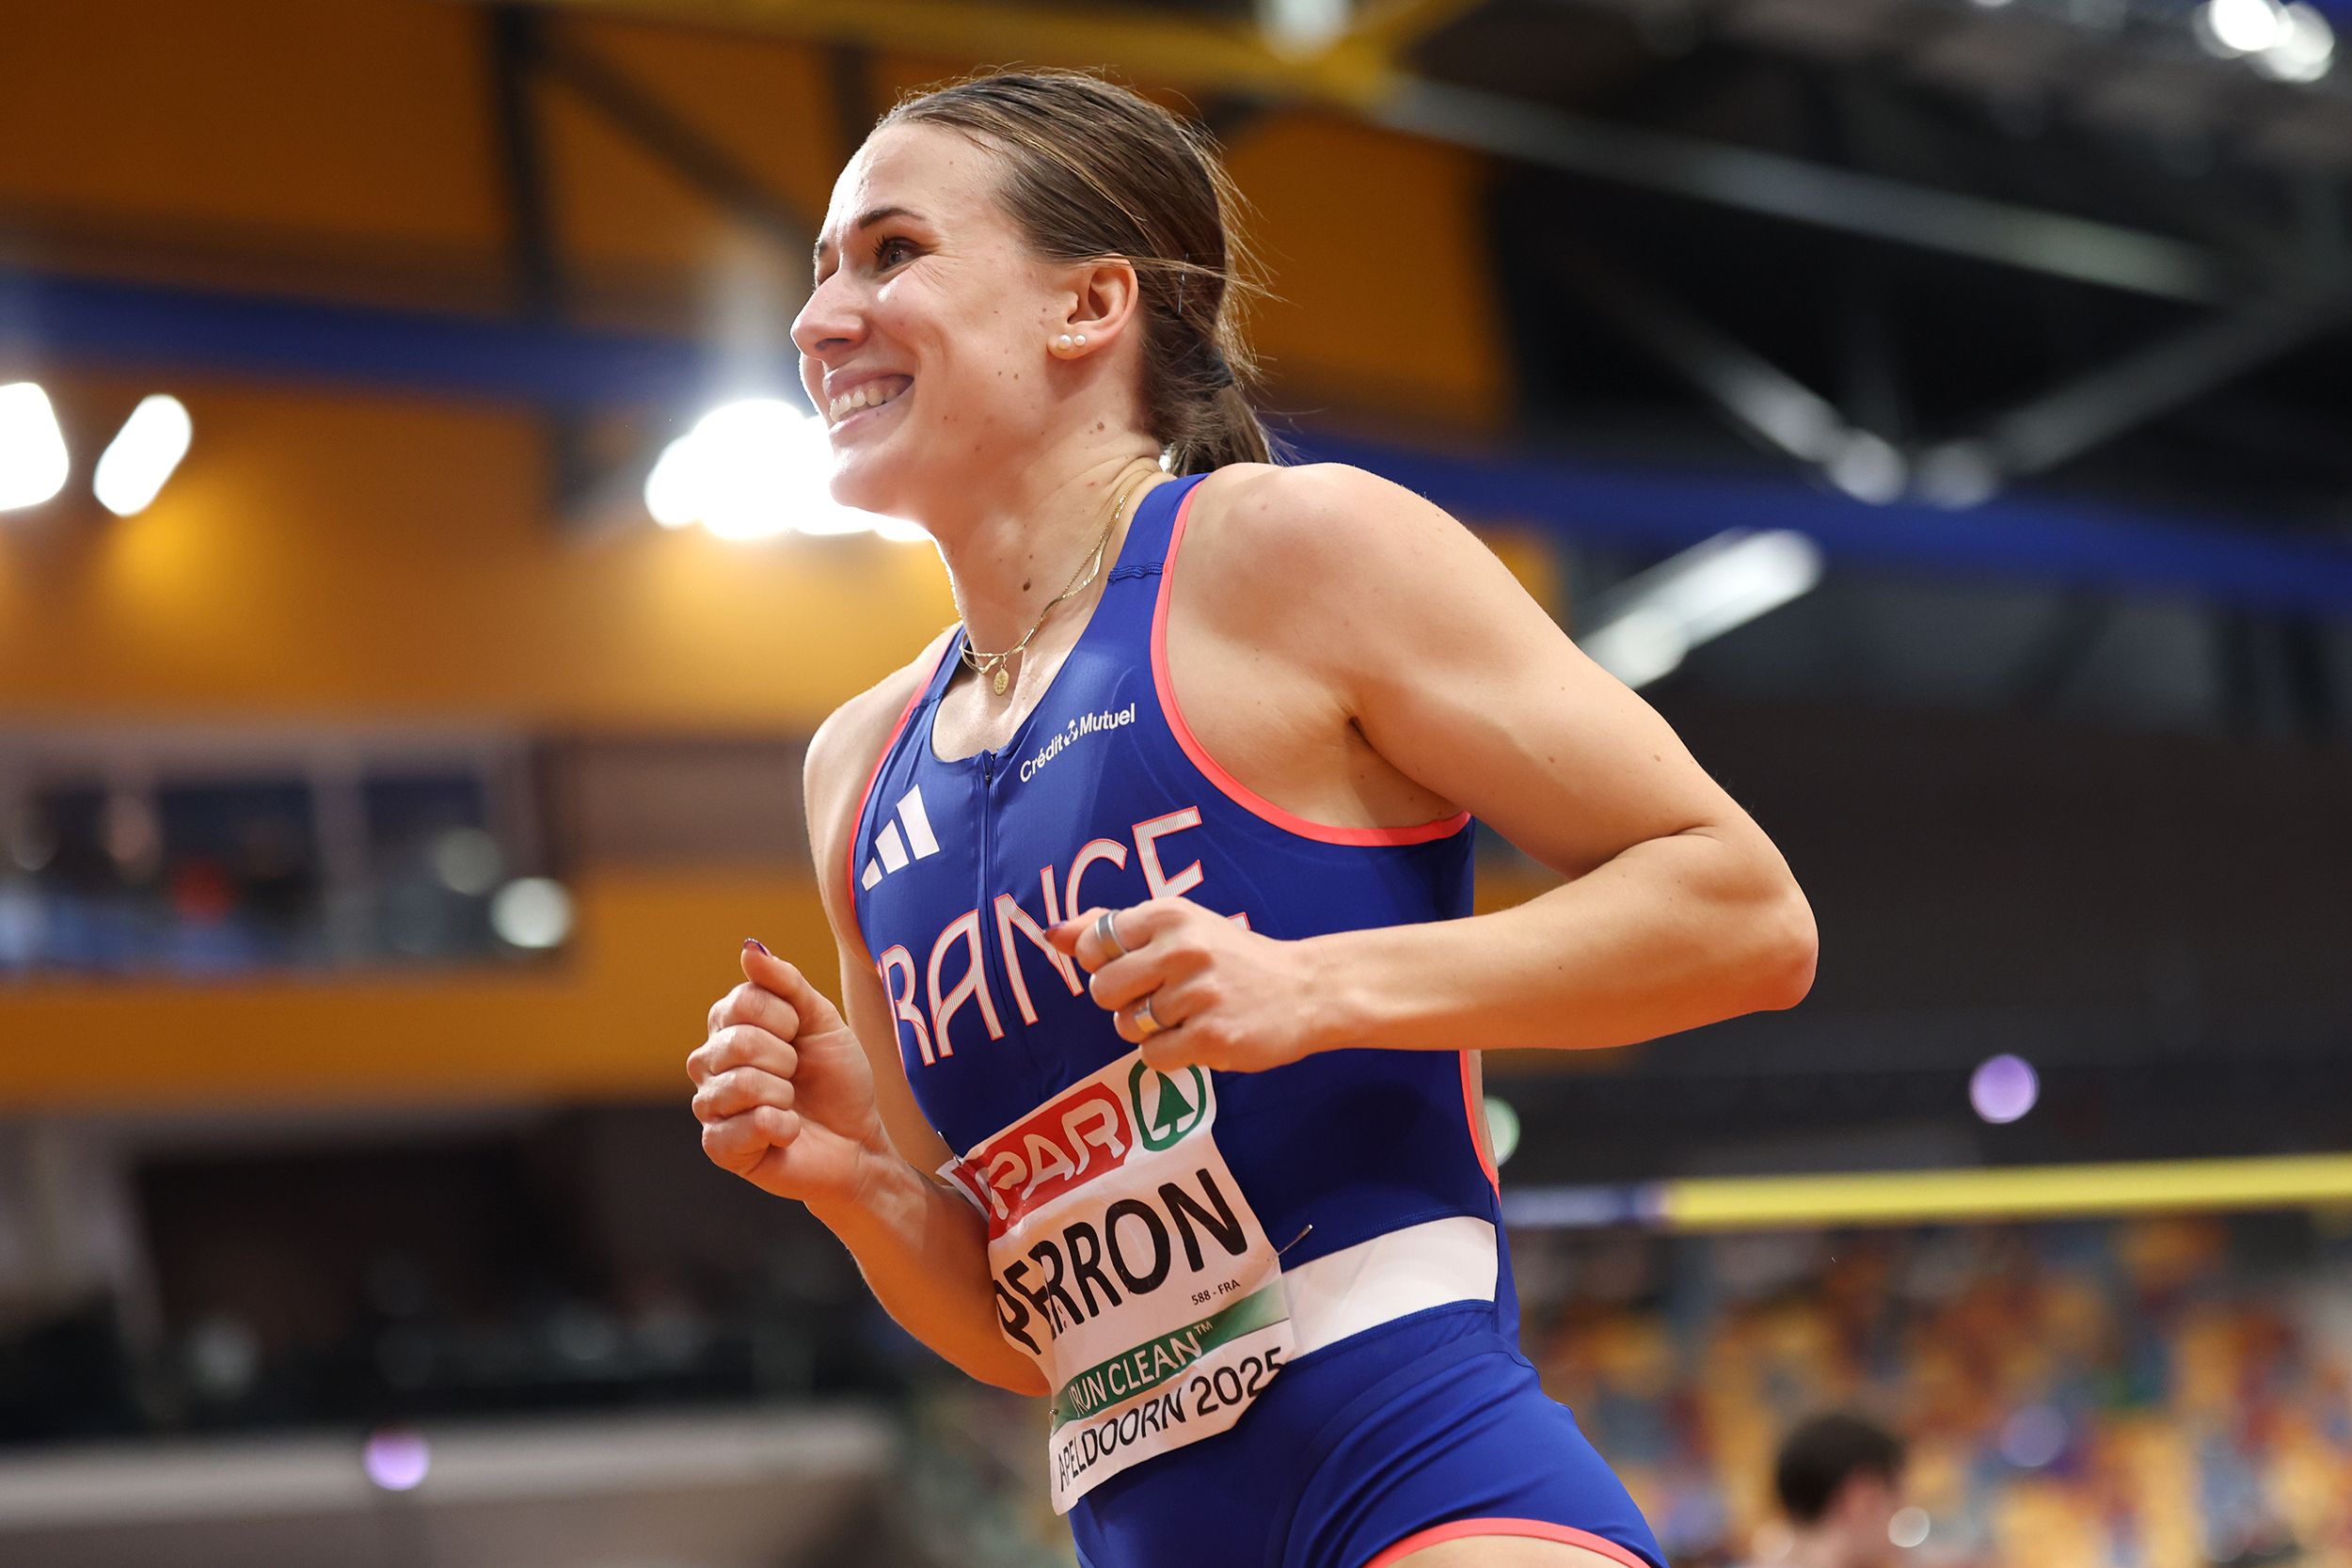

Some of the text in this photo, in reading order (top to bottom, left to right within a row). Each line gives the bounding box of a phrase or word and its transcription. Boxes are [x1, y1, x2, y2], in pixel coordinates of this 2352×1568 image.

[1020, 703, 1136, 783] Crédit Mutuel
[877, 806, 1250, 1074] RANCE
[975, 1098, 1125, 1221] PAR
[993, 1168, 1248, 1355] PERRON
[1191, 1291, 1211, 1306] 588
[1219, 1279, 1241, 1295] FRA
[1057, 1387, 1186, 1493] APELDOORN
[1069, 1371, 1107, 1418] RUN
